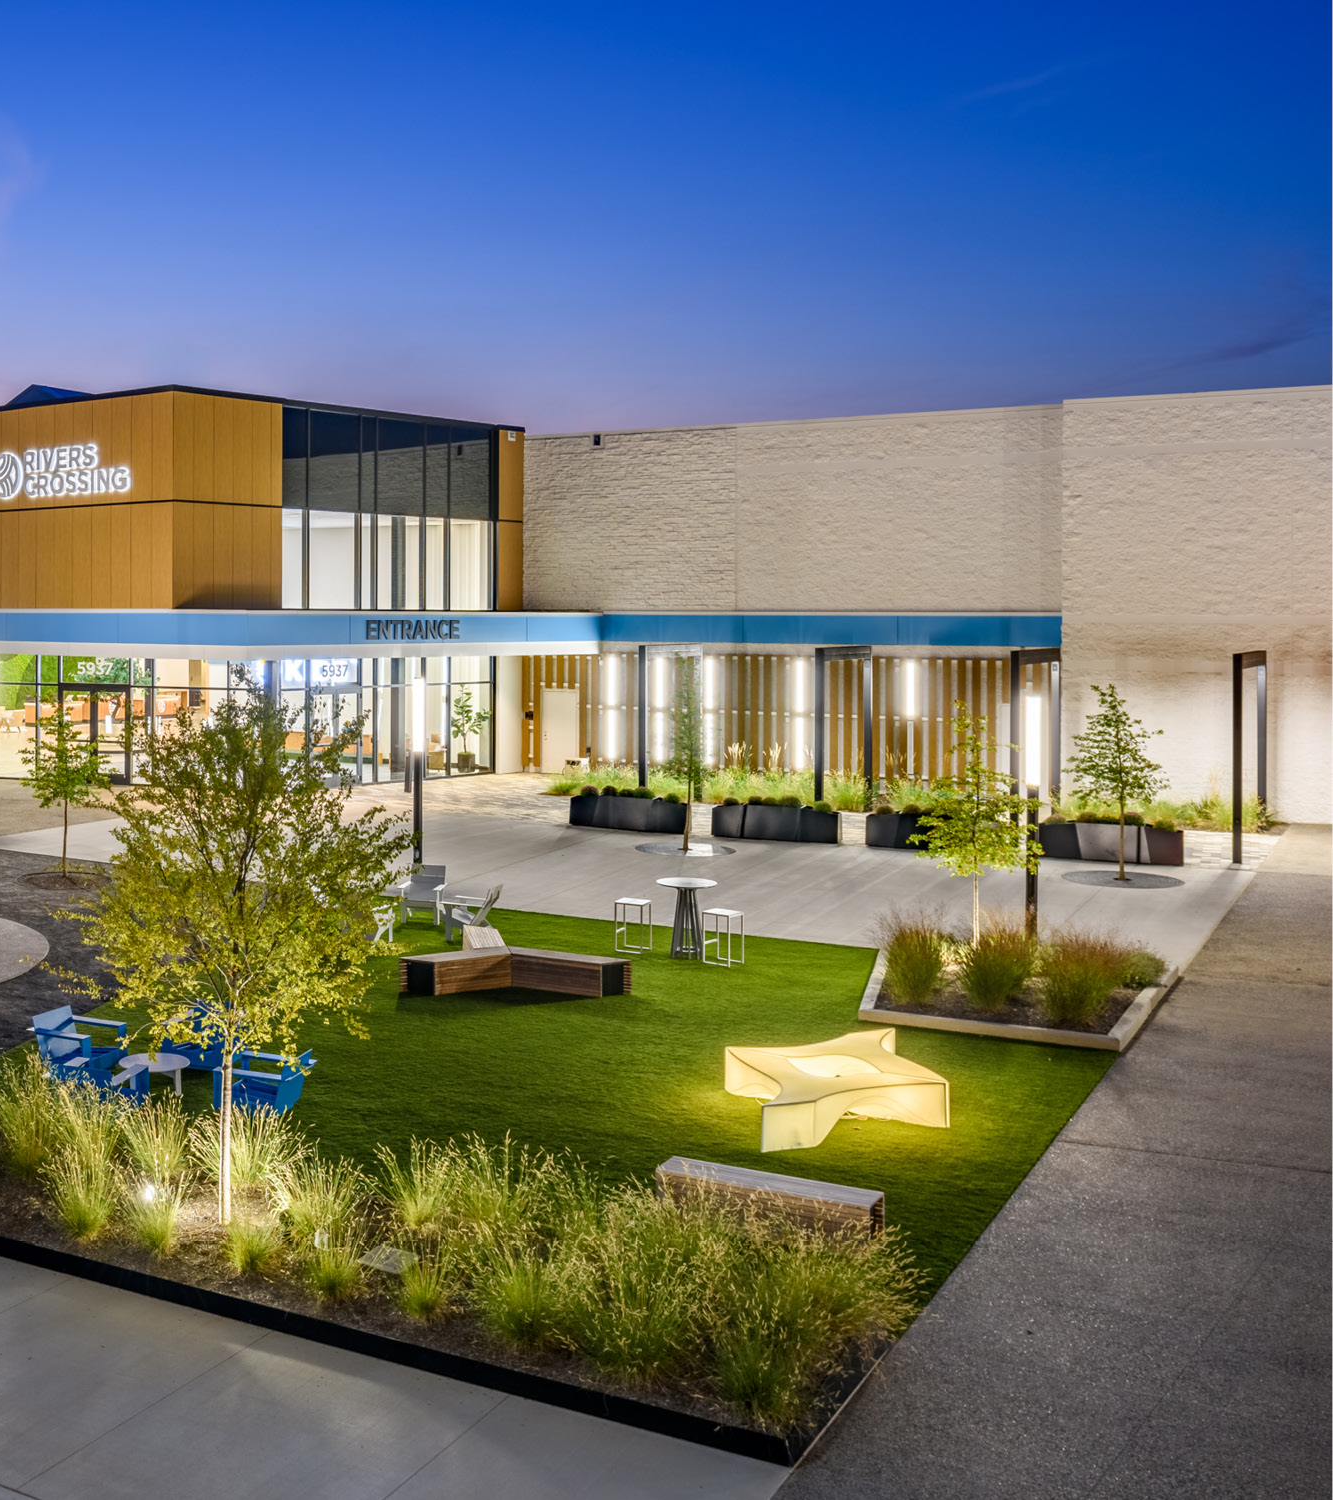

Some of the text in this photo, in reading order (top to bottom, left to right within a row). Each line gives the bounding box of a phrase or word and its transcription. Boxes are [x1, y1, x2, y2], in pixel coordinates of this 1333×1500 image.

[24, 445, 96, 472] RIVERS
[24, 467, 130, 496] CROSSING
[366, 619, 461, 640] ENTRANCE
[77, 661, 114, 676] 5937
[321, 664, 349, 678] 5937
